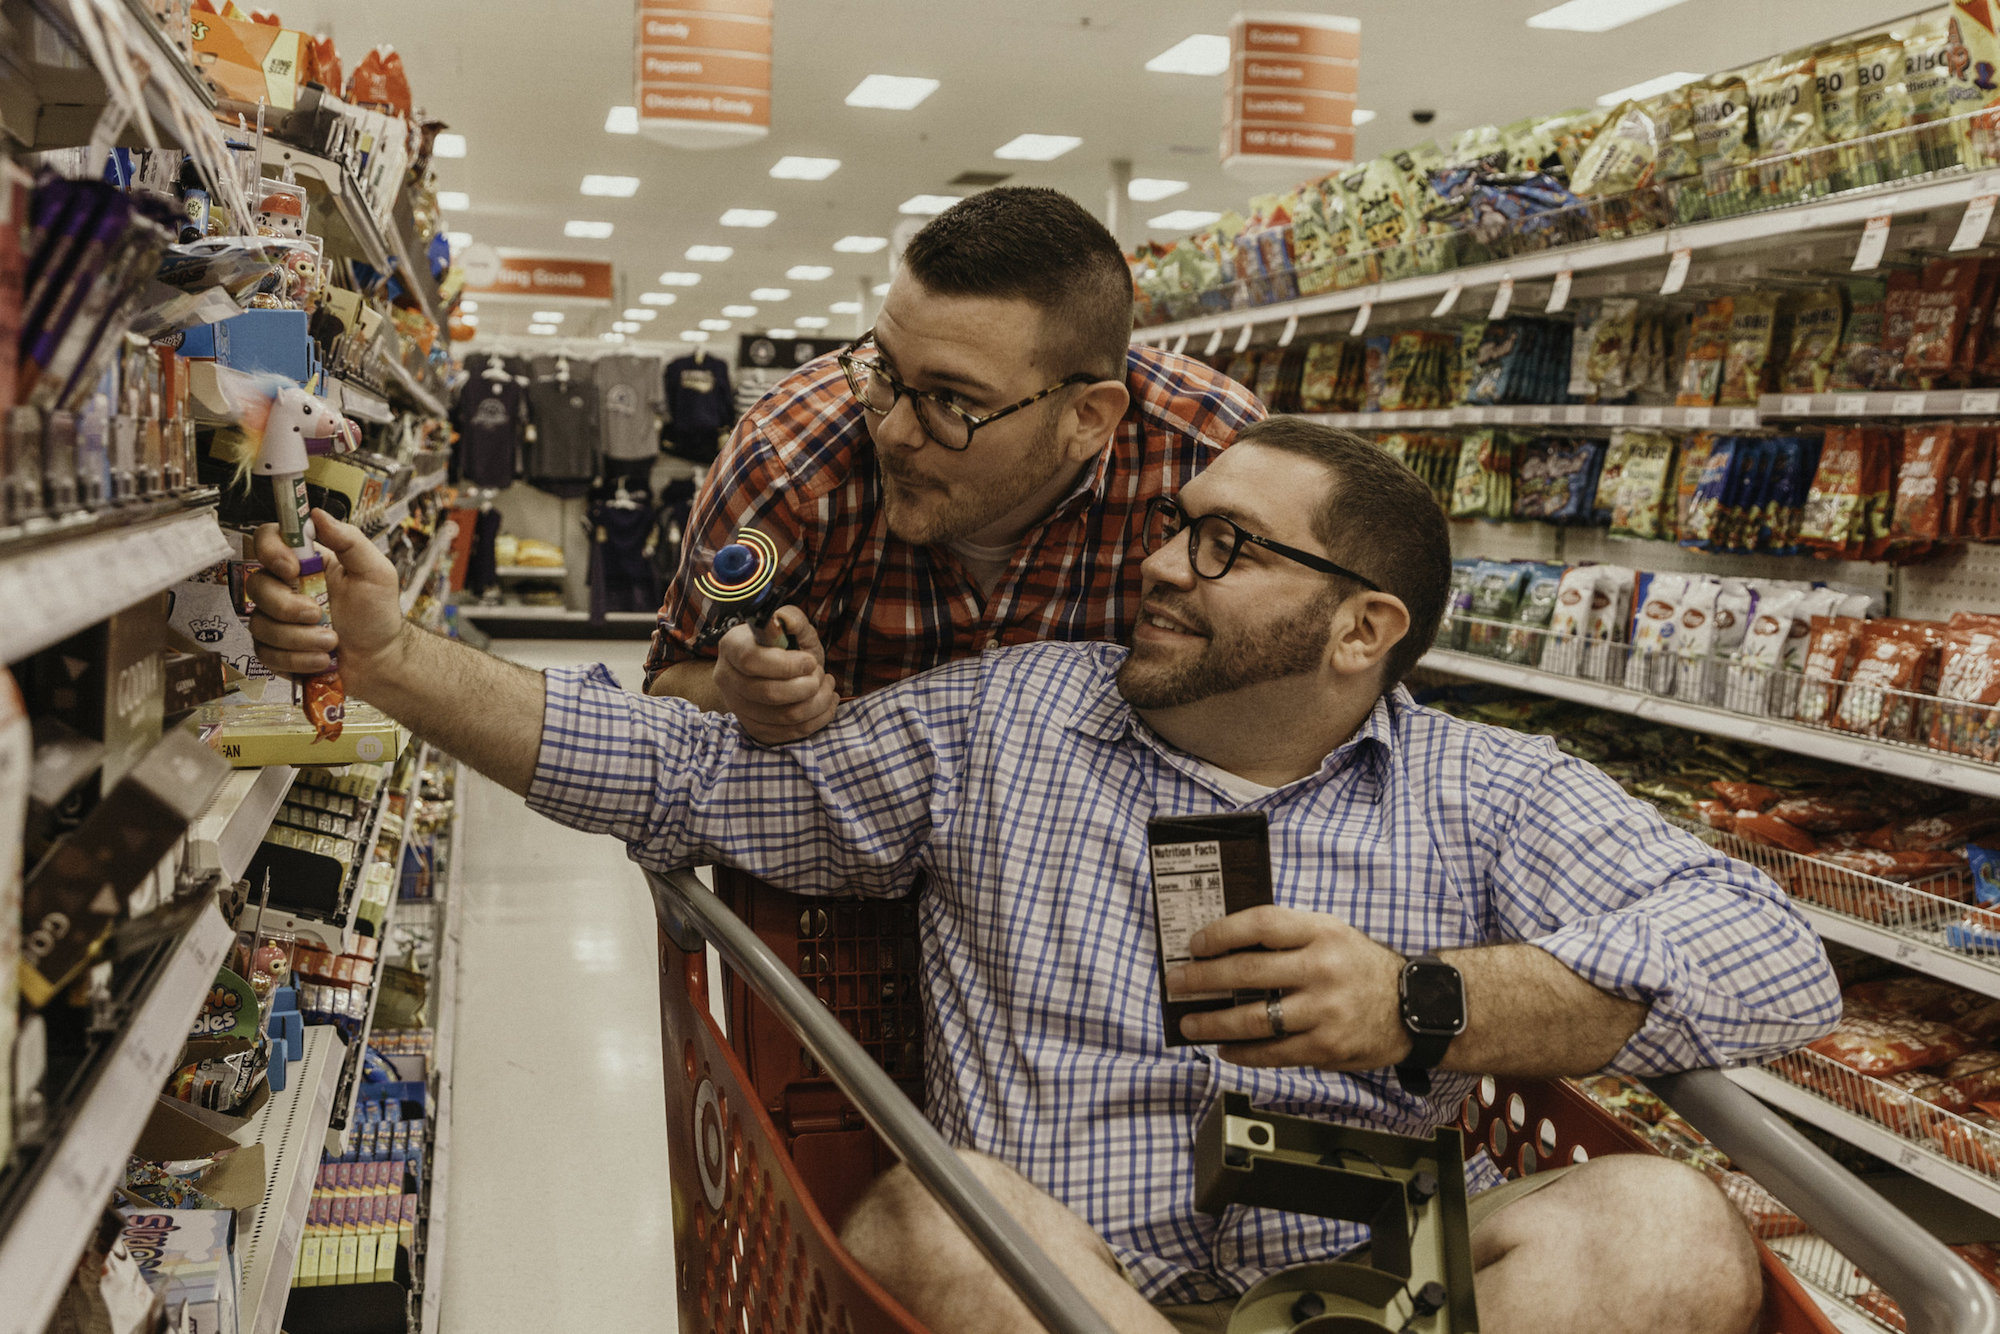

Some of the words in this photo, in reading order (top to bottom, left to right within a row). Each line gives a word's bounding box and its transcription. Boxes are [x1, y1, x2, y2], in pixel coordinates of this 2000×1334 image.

[646, 21, 690, 40] Candy
[645, 57, 703, 75] Popcorn
[645, 93, 711, 111] Chocolate
[712, 96, 754, 117] Candy
[190, 615, 228, 633] Radz
[1154, 846, 1192, 858] Nutrition
[1194, 844, 1218, 856] Facts
